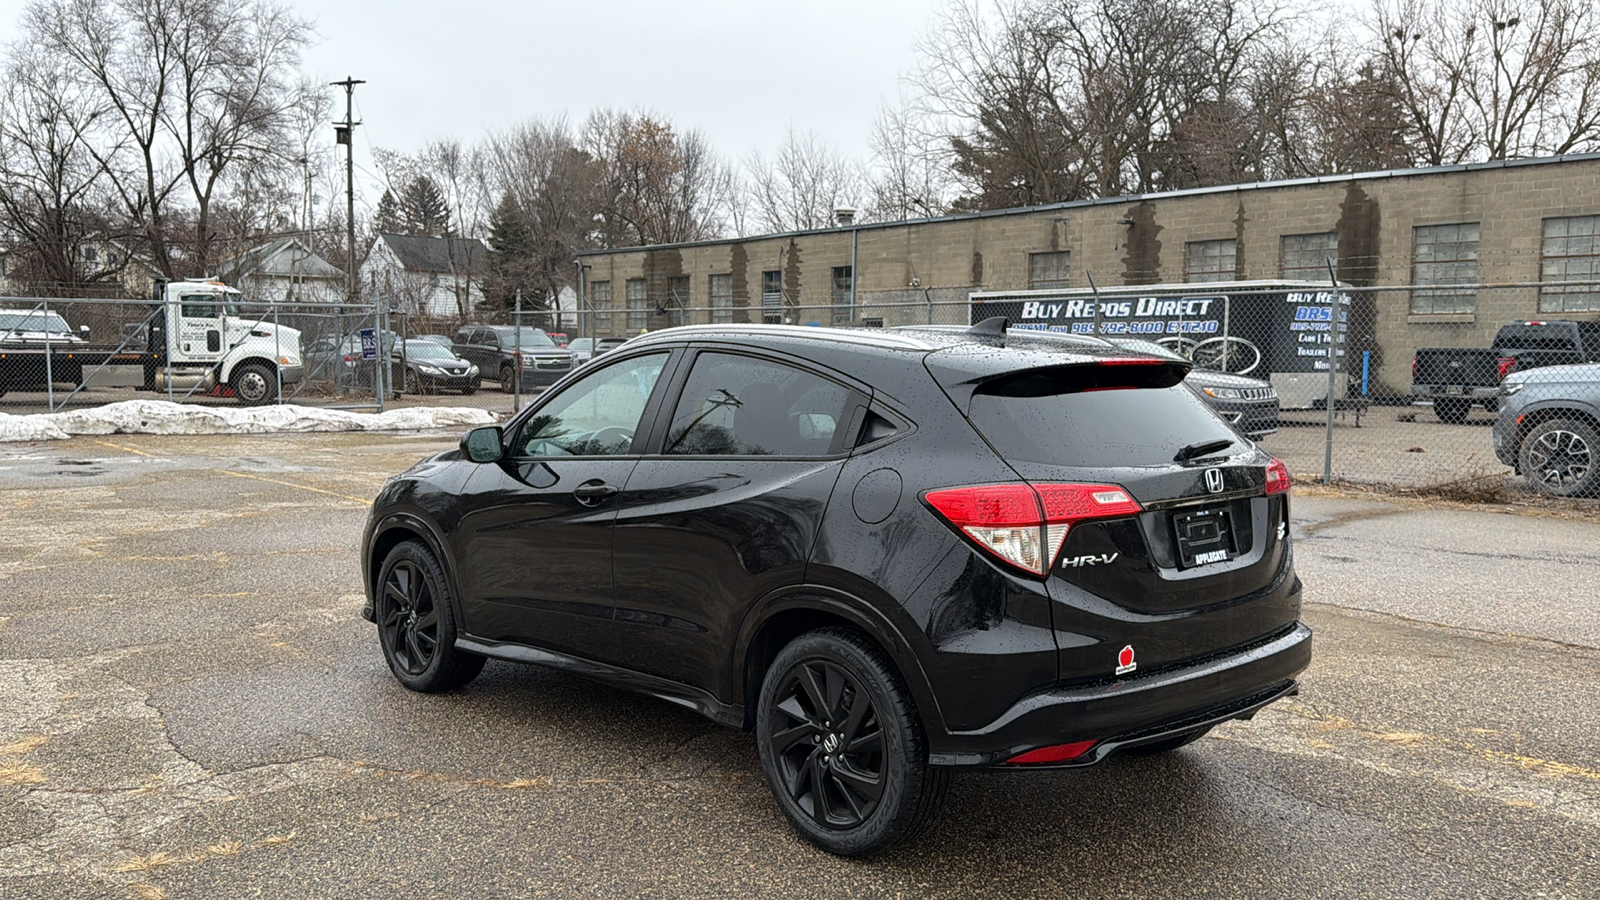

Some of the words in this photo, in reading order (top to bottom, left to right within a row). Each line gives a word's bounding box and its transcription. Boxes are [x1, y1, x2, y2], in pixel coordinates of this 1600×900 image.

[1021, 301, 1063, 319] BUY
[1065, 299, 1132, 318] REPOS
[1135, 297, 1213, 316] DIRECT
[1061, 552, 1119, 569] HR-V
[1195, 550, 1228, 565] APPLEGATE
